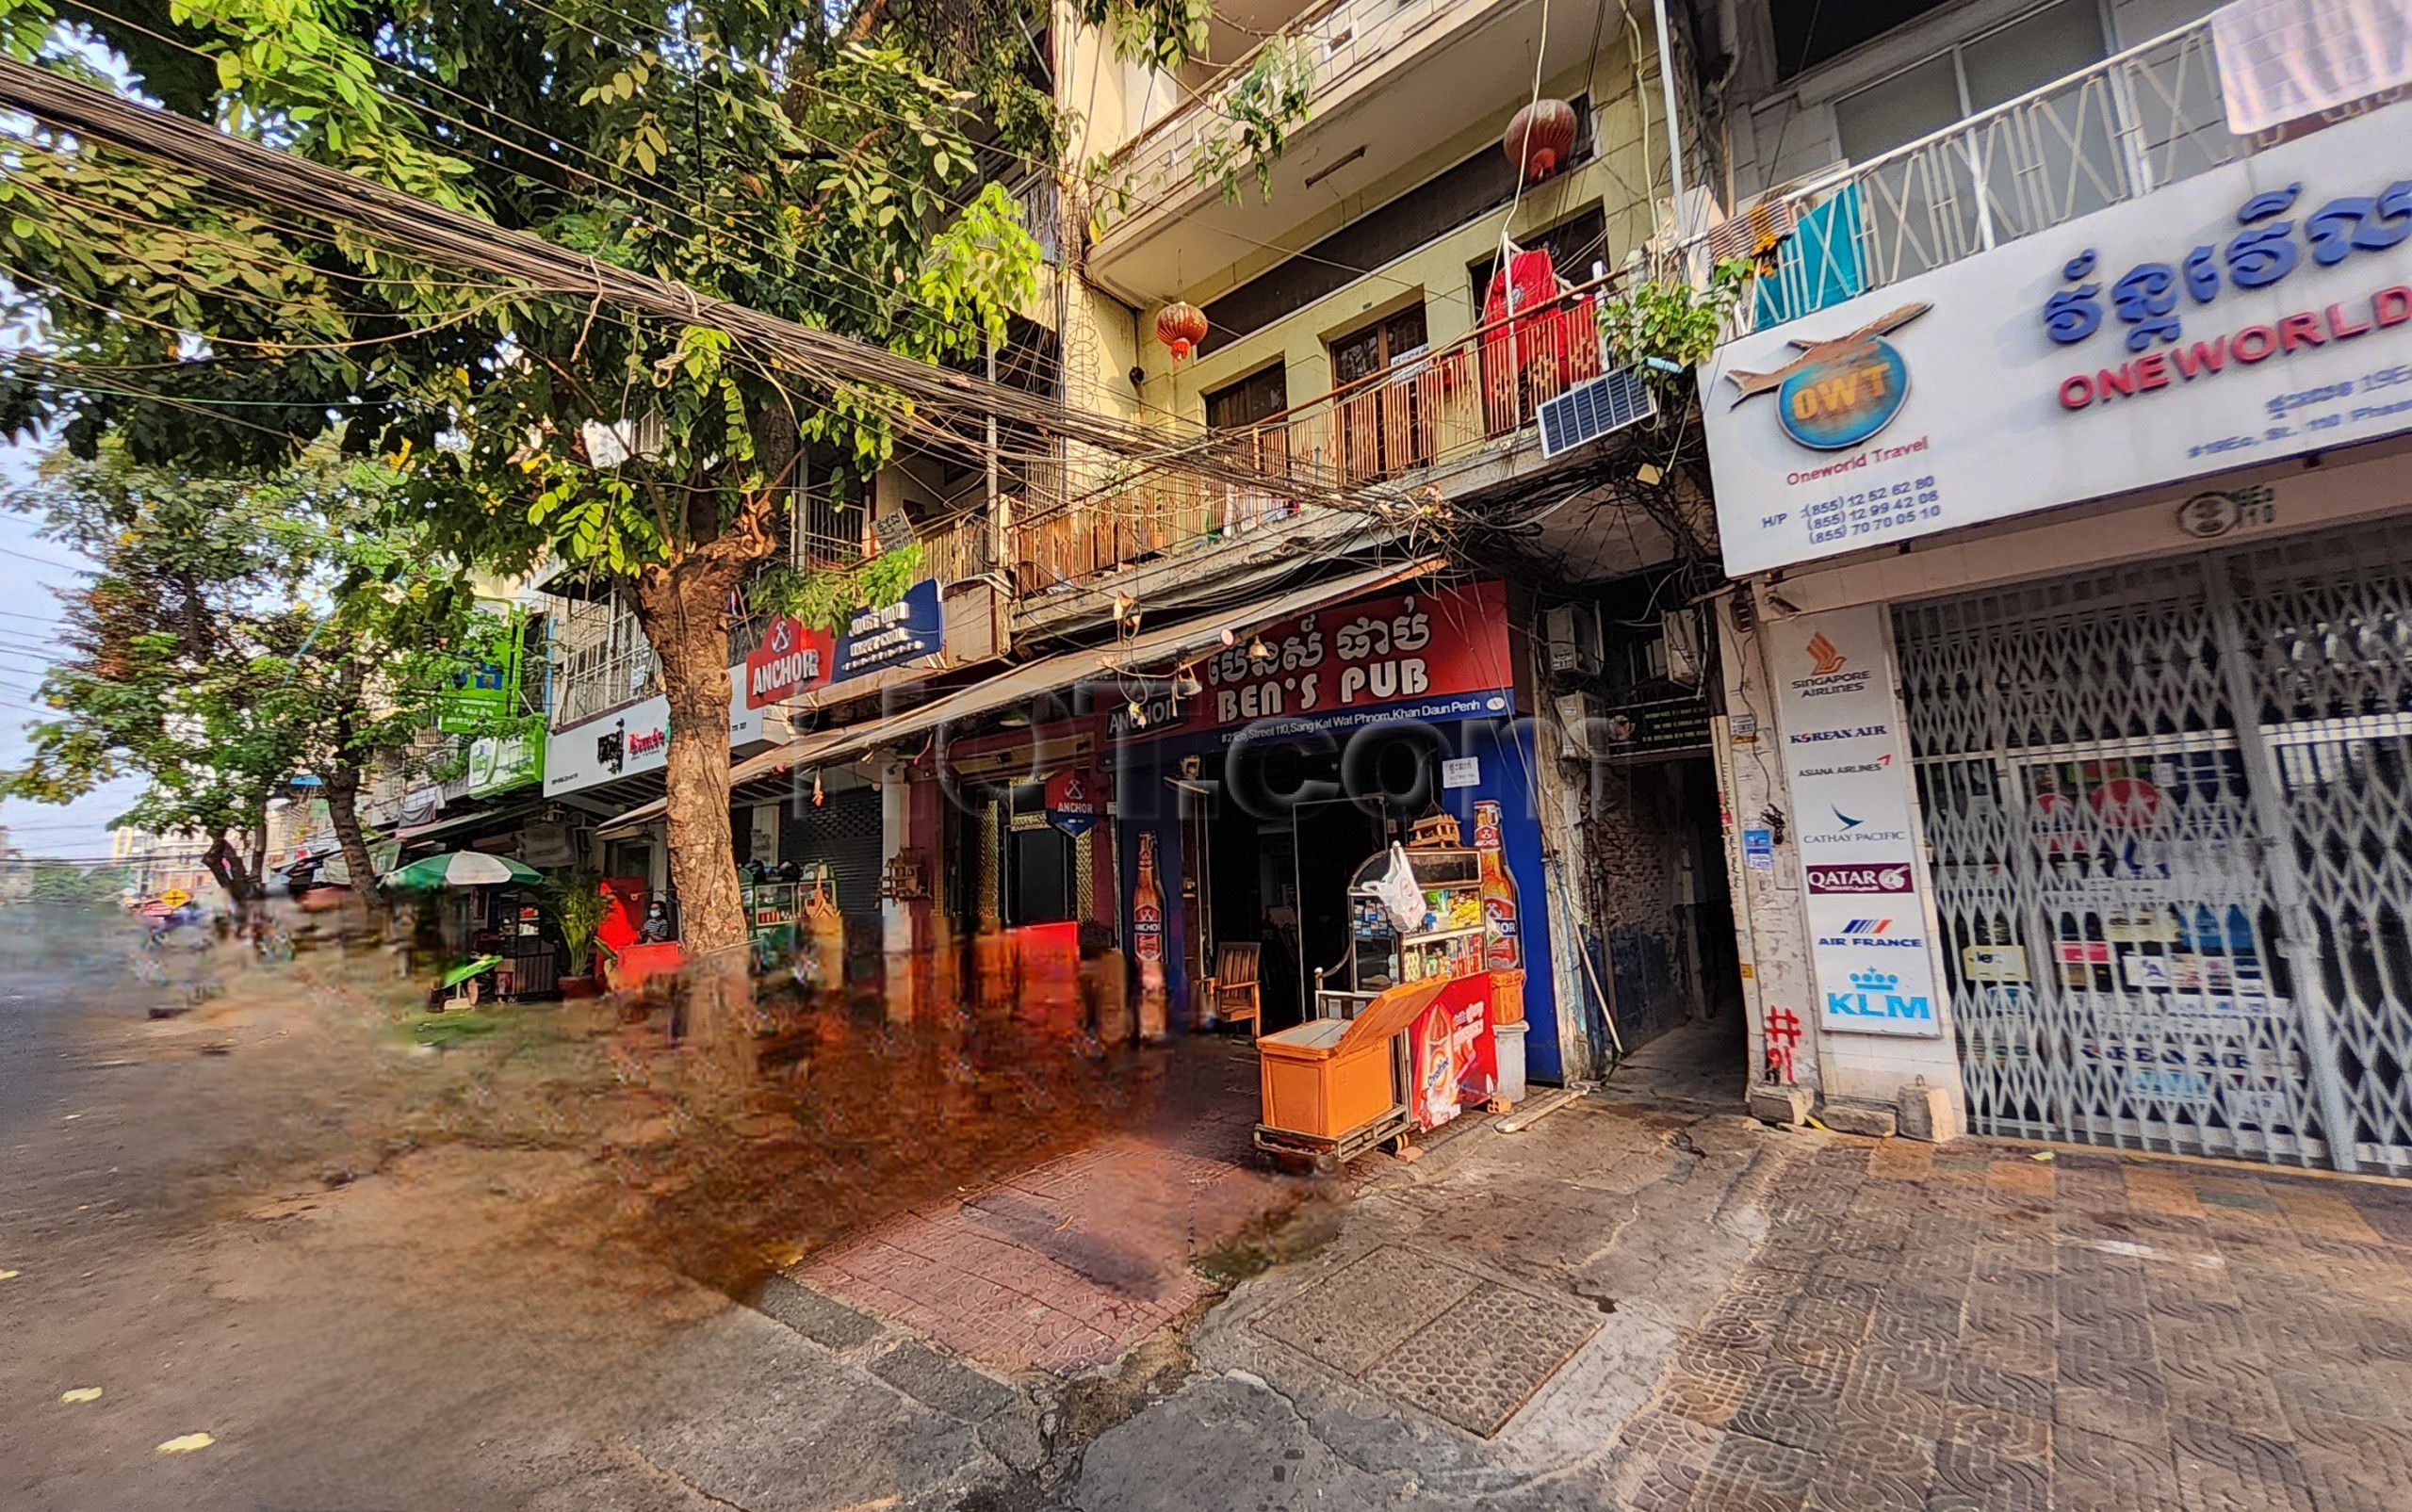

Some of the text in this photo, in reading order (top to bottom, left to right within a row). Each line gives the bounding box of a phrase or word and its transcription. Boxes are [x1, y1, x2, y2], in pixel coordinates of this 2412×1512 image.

[2058, 285, 2412, 409] ONEWORLD
[1793, 362, 1890, 420] OWT
[1786, 436, 1930, 486] Oneworld Travel
[1807, 511, 1846, 530] (855)
[1809, 525, 1848, 545] (855)
[752, 648, 819, 695] ANCHOR
[1792, 671, 1871, 690] SINGAPORE
[1217, 658, 1429, 723] BEN'S PUB
[1801, 682, 1865, 698] AIRLINES
[1422, 705, 1450, 716] Daun
[1451, 700, 1480, 712] Penh
[1853, 724, 1887, 738] AIR
[1799, 763, 1882, 777] ASIANA AIRLINES
[1057, 802, 1093, 814] ANCHOR
[1803, 831, 1905, 844] CATHAY PACIFIC
[1808, 870, 1878, 888] QATAR
[1818, 937, 1923, 948] AIR FRANCE
[1827, 992, 1931, 1019] KLM
